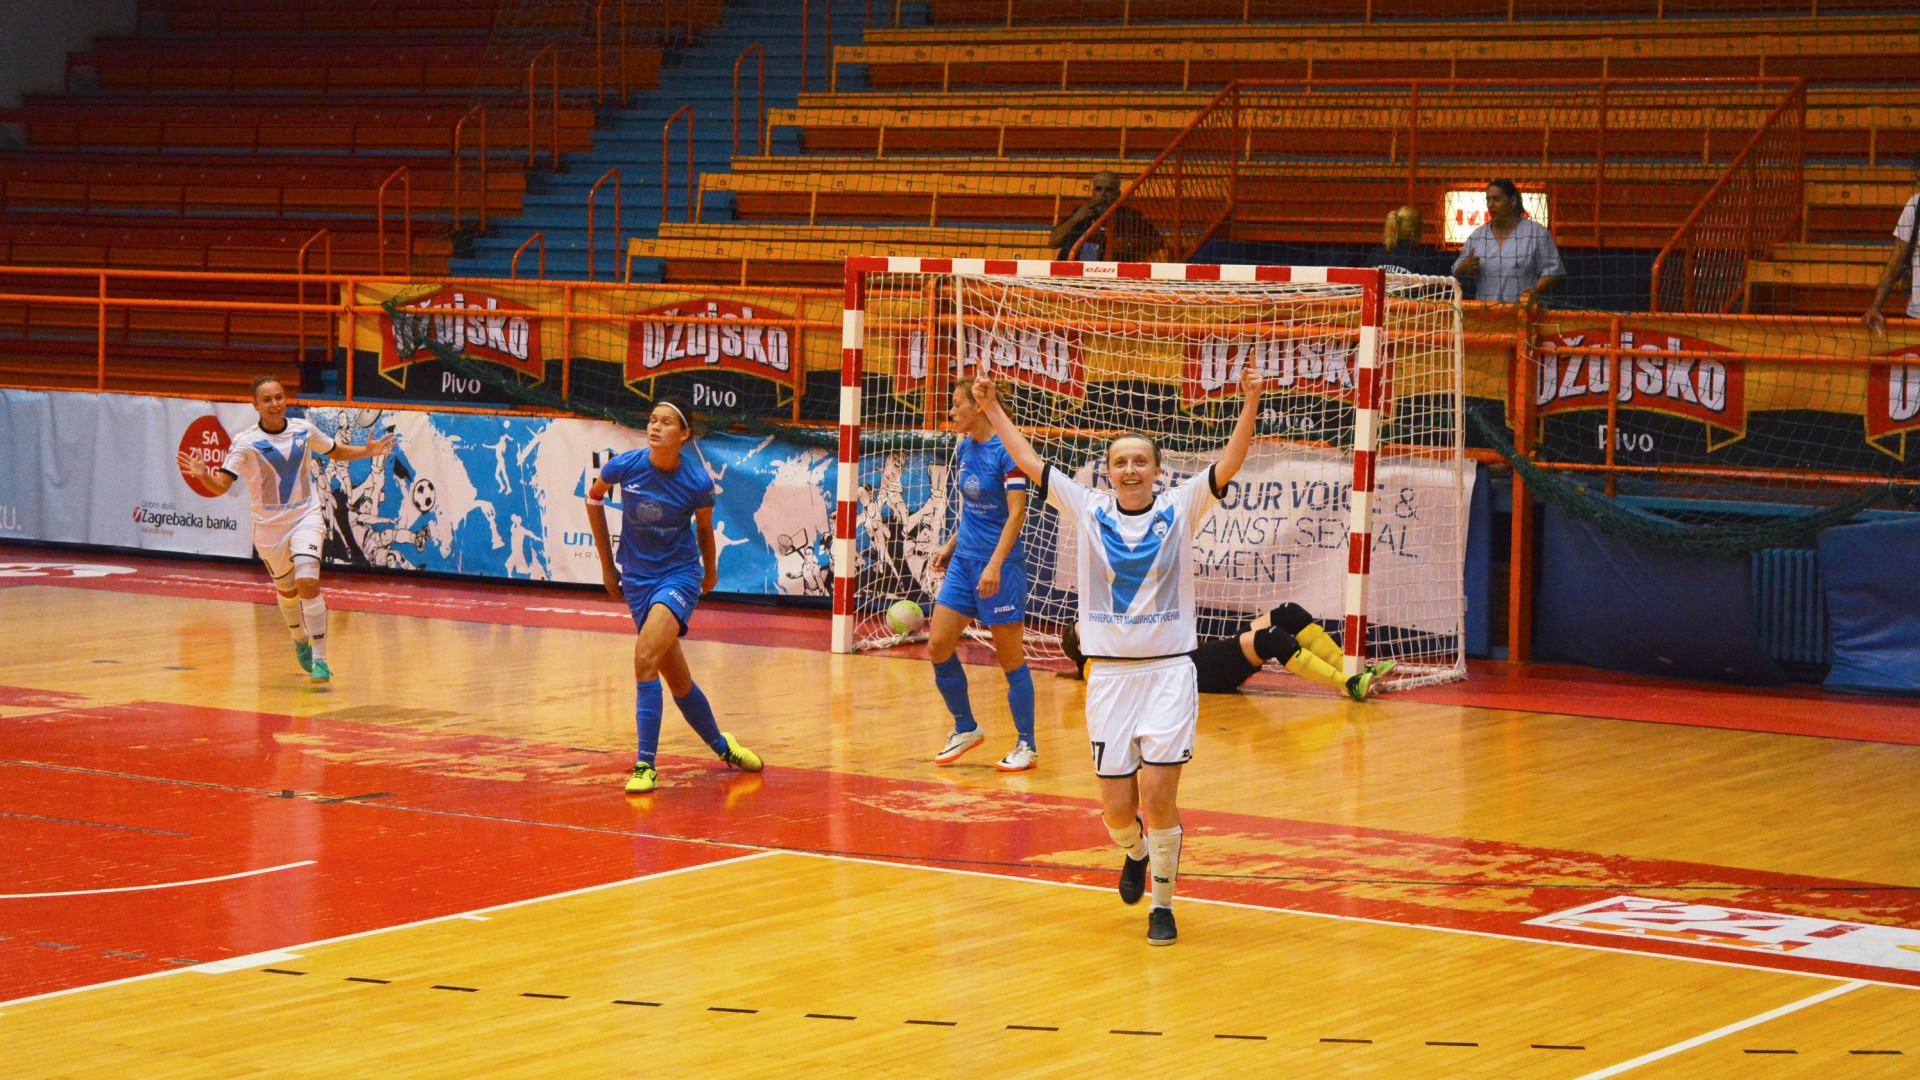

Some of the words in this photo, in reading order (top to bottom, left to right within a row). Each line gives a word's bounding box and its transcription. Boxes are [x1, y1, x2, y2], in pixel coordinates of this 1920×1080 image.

[442, 371, 481, 394] Pivo
[693, 383, 737, 408] Pivo
[202, 431, 219, 445] SA
[1598, 424, 1654, 452] Pivo
[1220, 480, 1283, 511] OUR
[1395, 487, 1419, 520] &
[142, 509, 203, 528] Zagrebačka
[206, 515, 237, 531] banka
[1295, 517, 1418, 558] SEXAL
